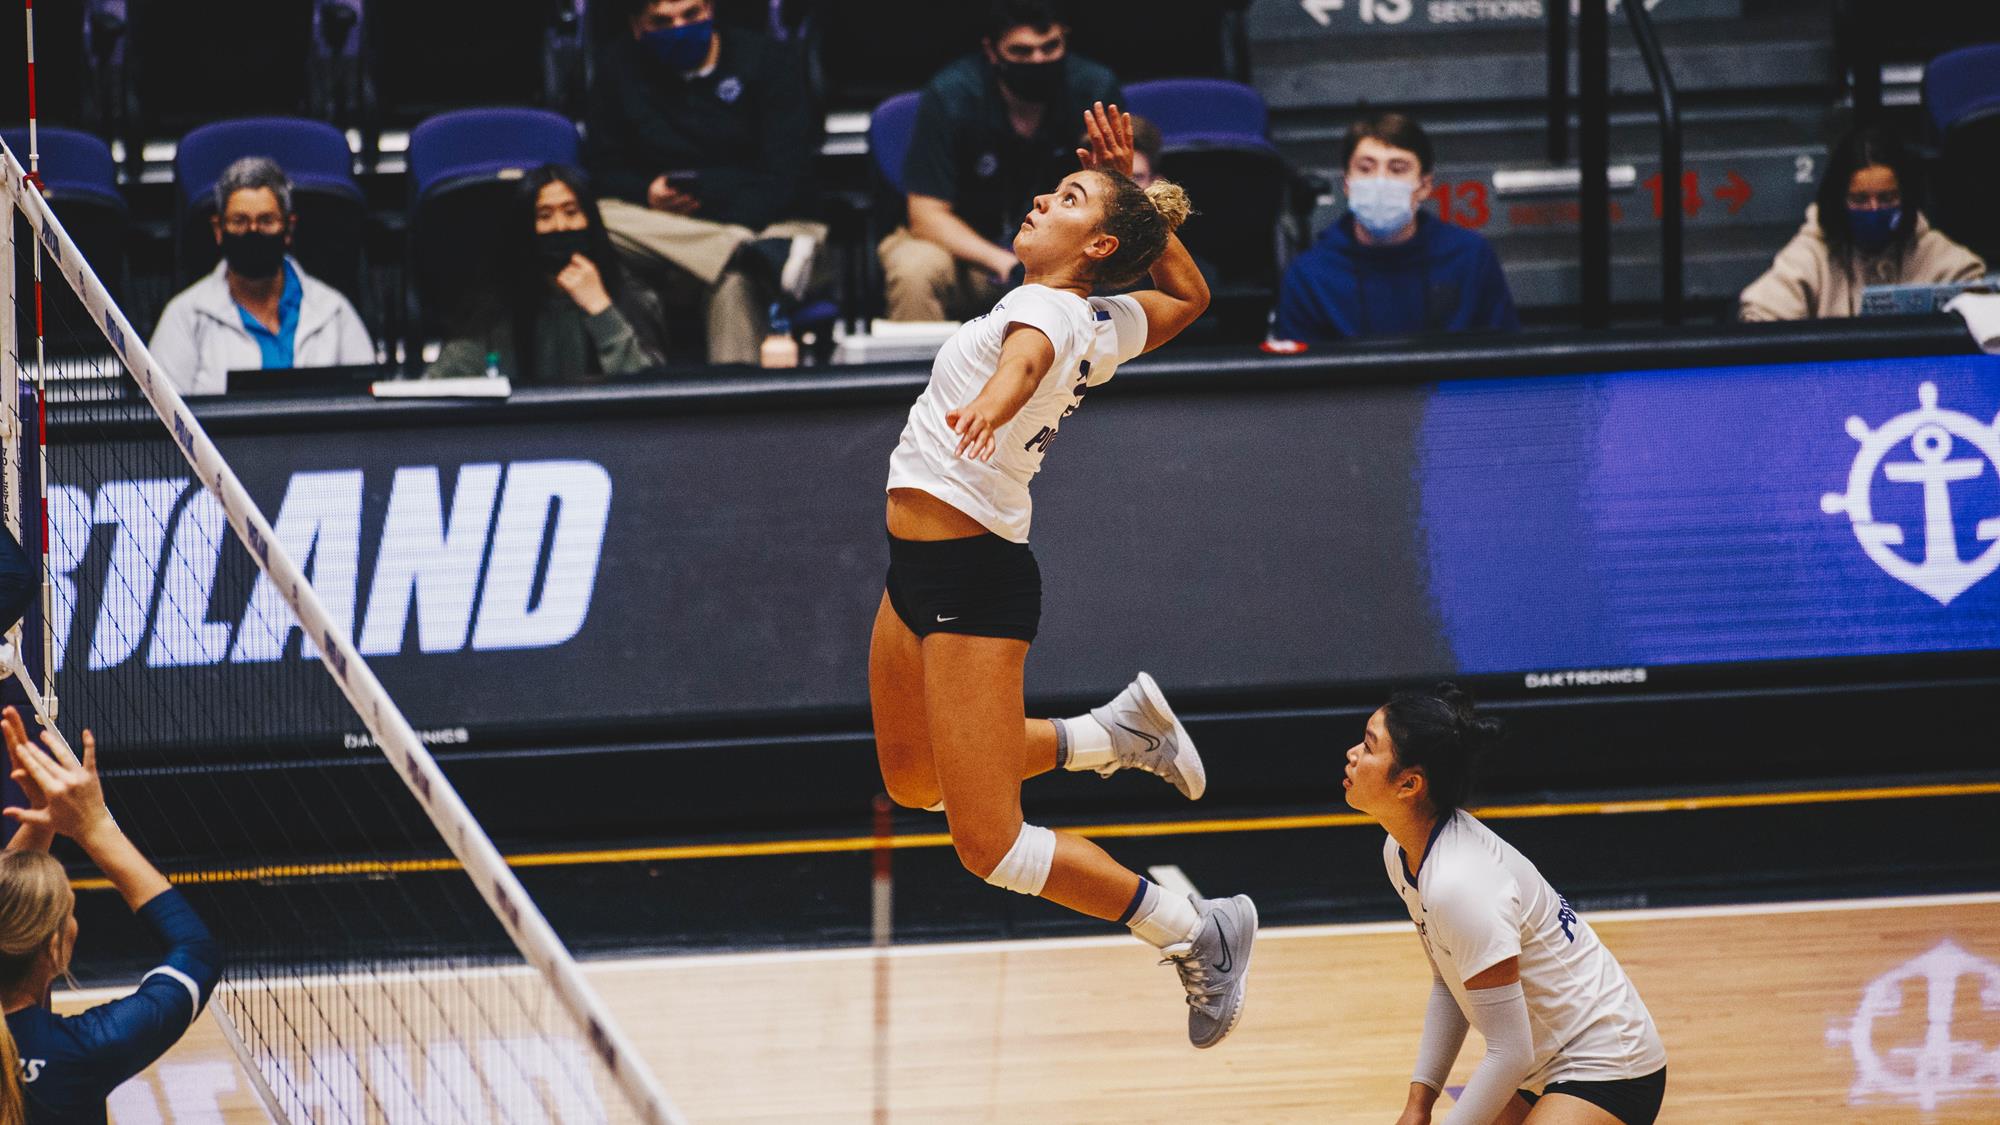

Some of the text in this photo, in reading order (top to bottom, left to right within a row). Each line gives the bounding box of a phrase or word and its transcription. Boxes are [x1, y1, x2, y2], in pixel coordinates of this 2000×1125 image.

[1427, 0, 1543, 23] SECTIONS
[1795, 156, 1814, 183] 2
[1525, 668, 1647, 688] DAKTRONICS
